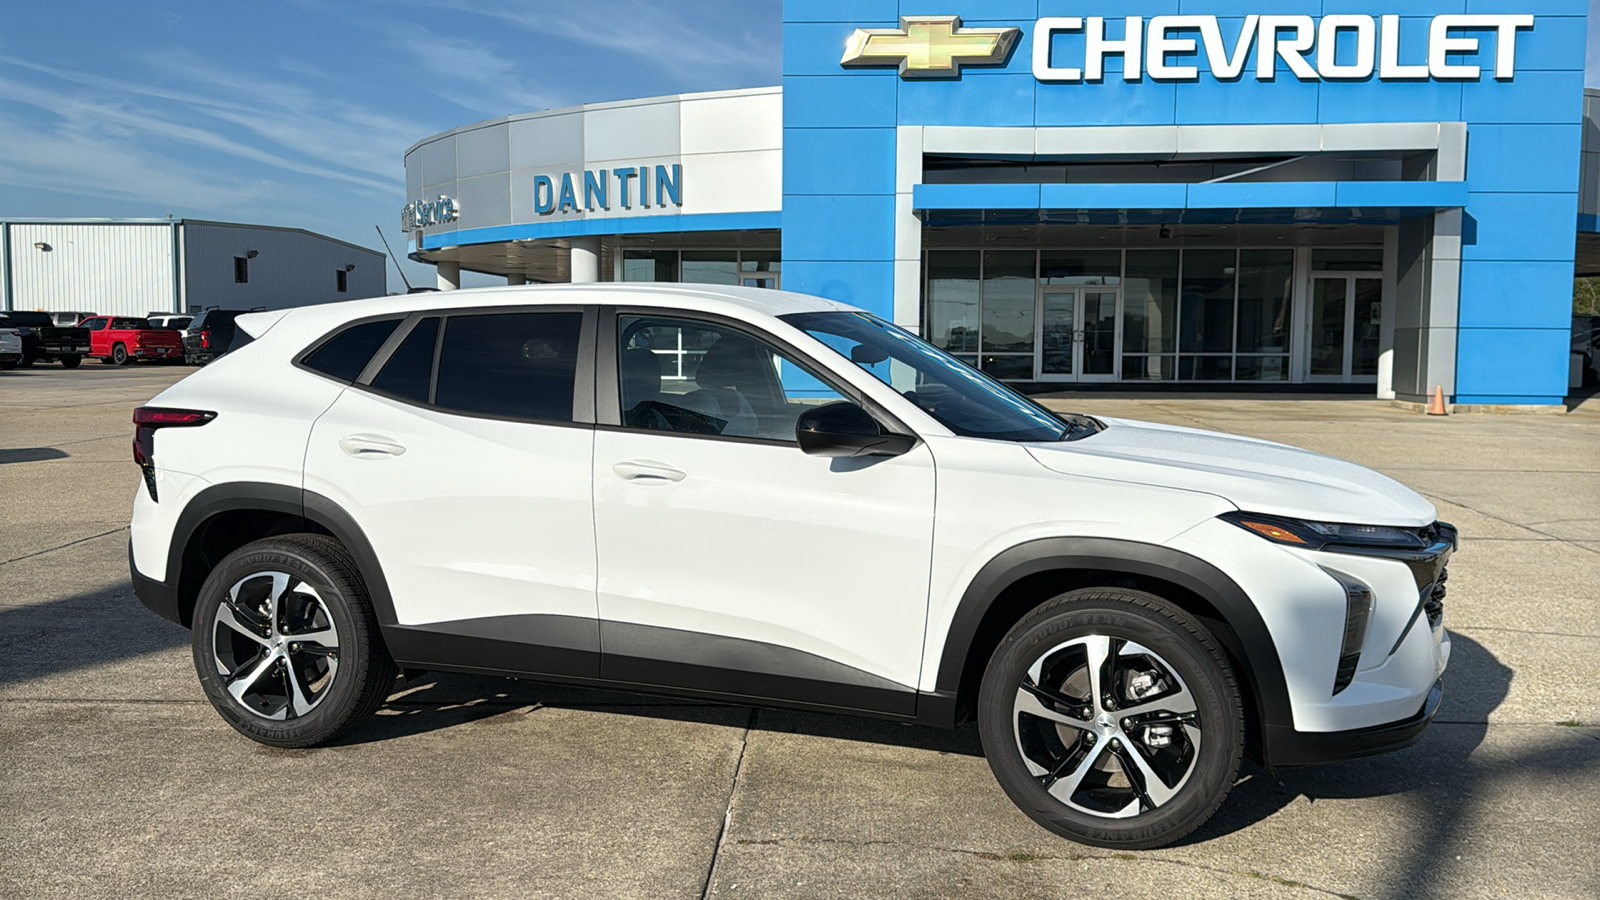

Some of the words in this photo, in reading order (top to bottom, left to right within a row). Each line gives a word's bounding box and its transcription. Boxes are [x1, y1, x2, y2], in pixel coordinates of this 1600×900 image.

[1032, 15, 1534, 82] CHEVROLET
[416, 195, 457, 226] Service
[534, 164, 681, 214] DANTIN
